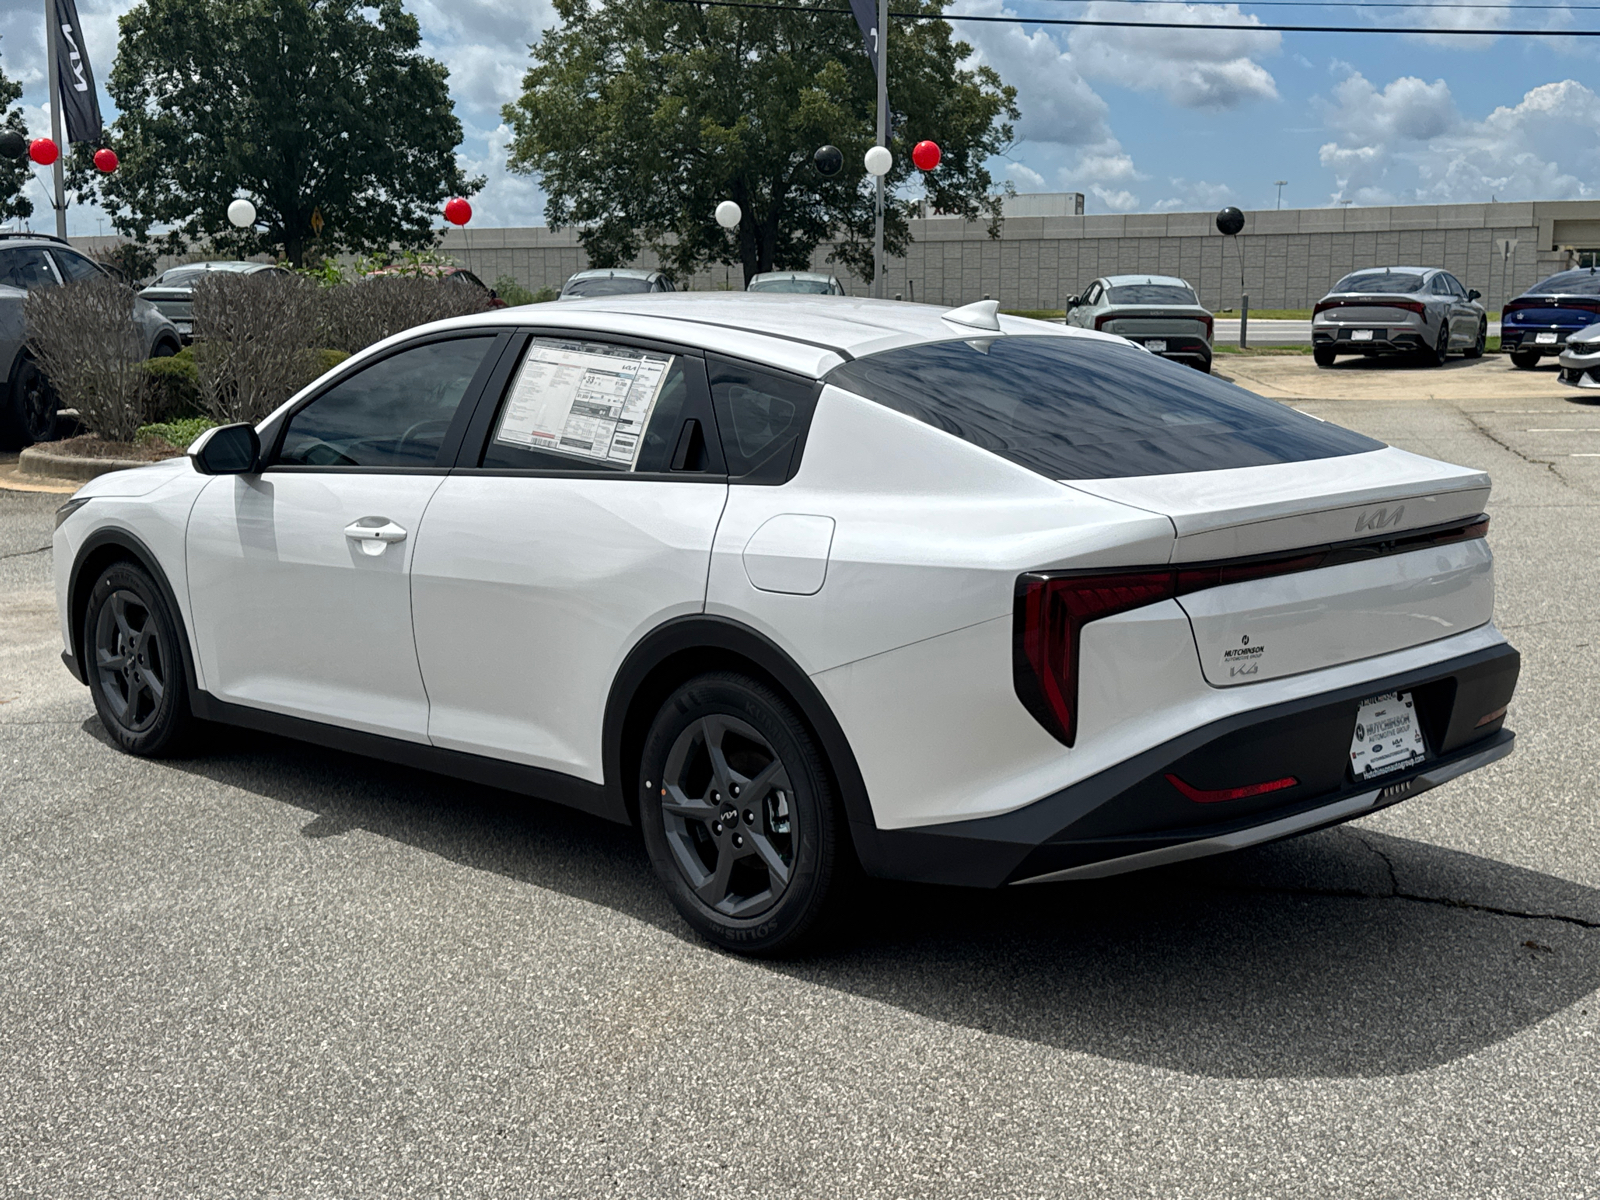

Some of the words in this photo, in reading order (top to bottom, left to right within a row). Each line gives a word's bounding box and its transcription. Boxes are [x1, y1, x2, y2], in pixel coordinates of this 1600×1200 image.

[61, 23, 88, 92] KIA
[1355, 505, 1405, 532] KIA
[1224, 645, 1265, 657] HUTCHINSON
[1366, 713, 1411, 737] HUTCHINSON
[1368, 729, 1397, 743] AUTOMOTIVE
